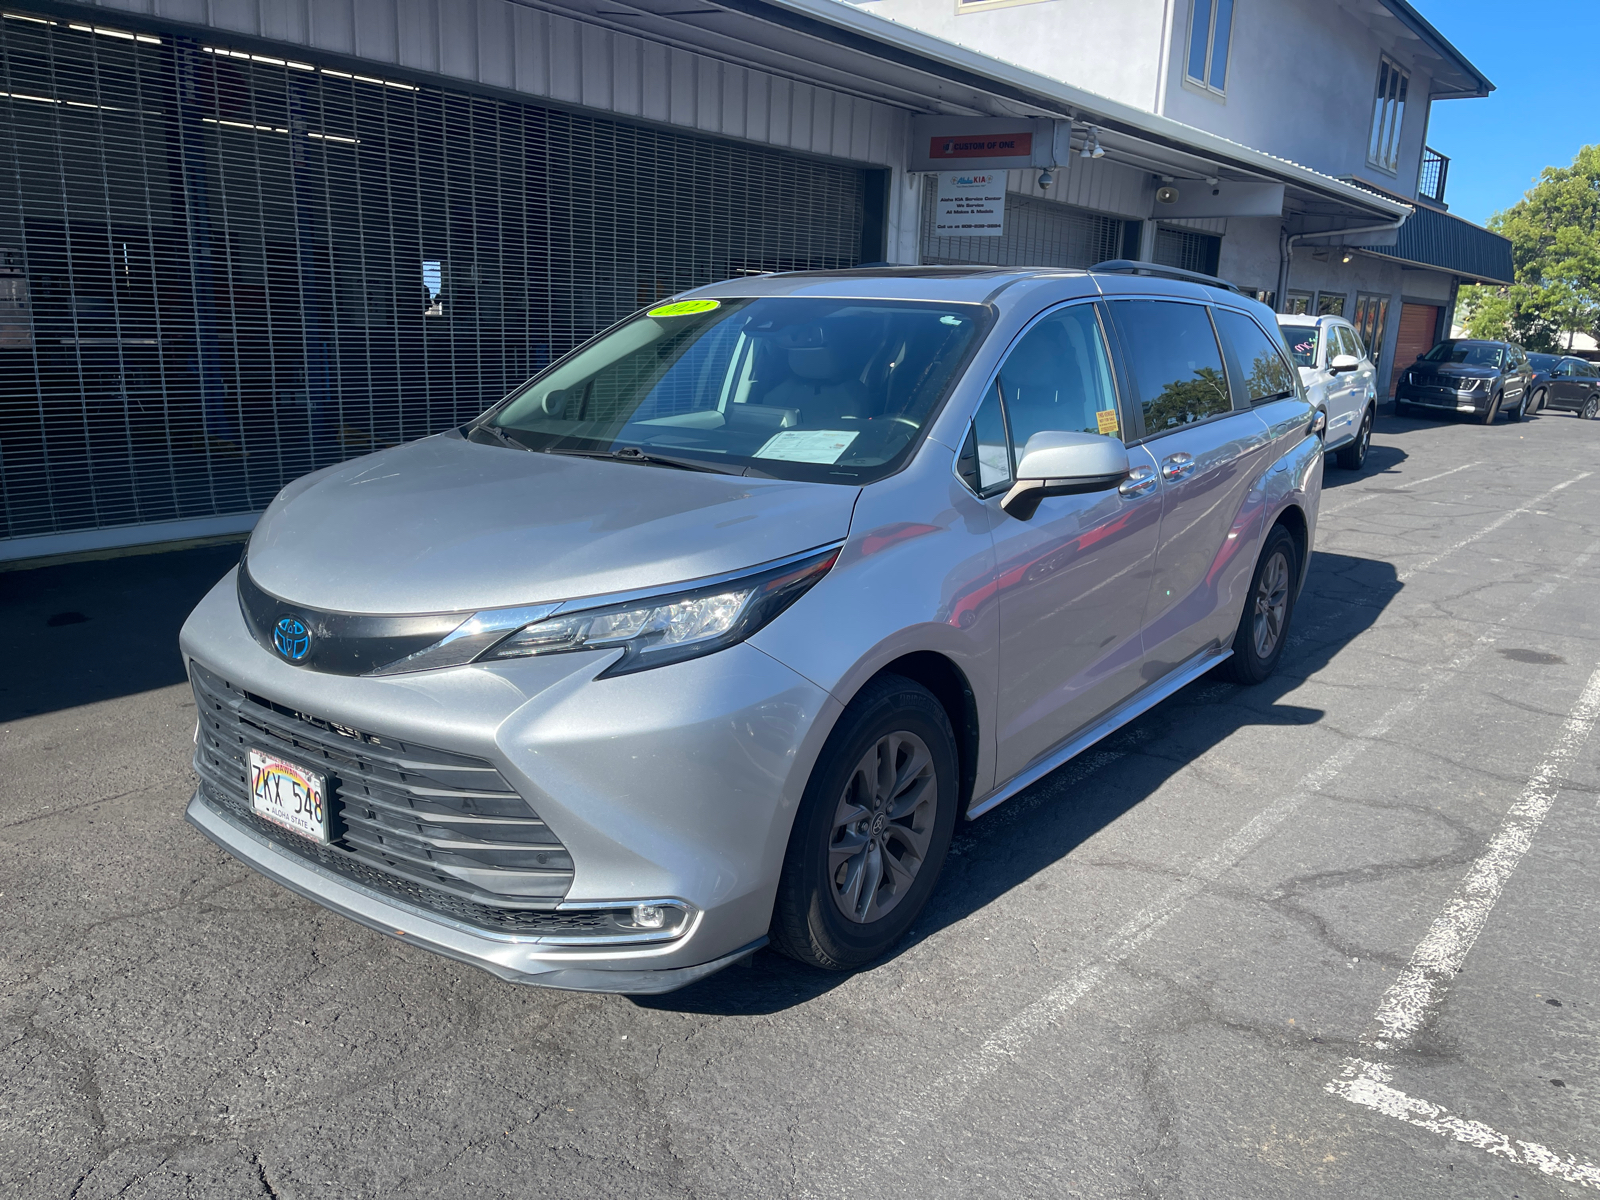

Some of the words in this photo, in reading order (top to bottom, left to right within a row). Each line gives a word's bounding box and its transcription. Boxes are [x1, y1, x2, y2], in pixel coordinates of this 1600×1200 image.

[954, 142, 985, 150] CUSTOM
[987, 142, 997, 150] OF
[998, 140, 1015, 149] ONE
[973, 176, 986, 184] KIA
[252, 764, 283, 807] ZKX
[292, 780, 323, 824] 548
[271, 806, 290, 820] ALOHA
[290, 815, 308, 829] STATE
